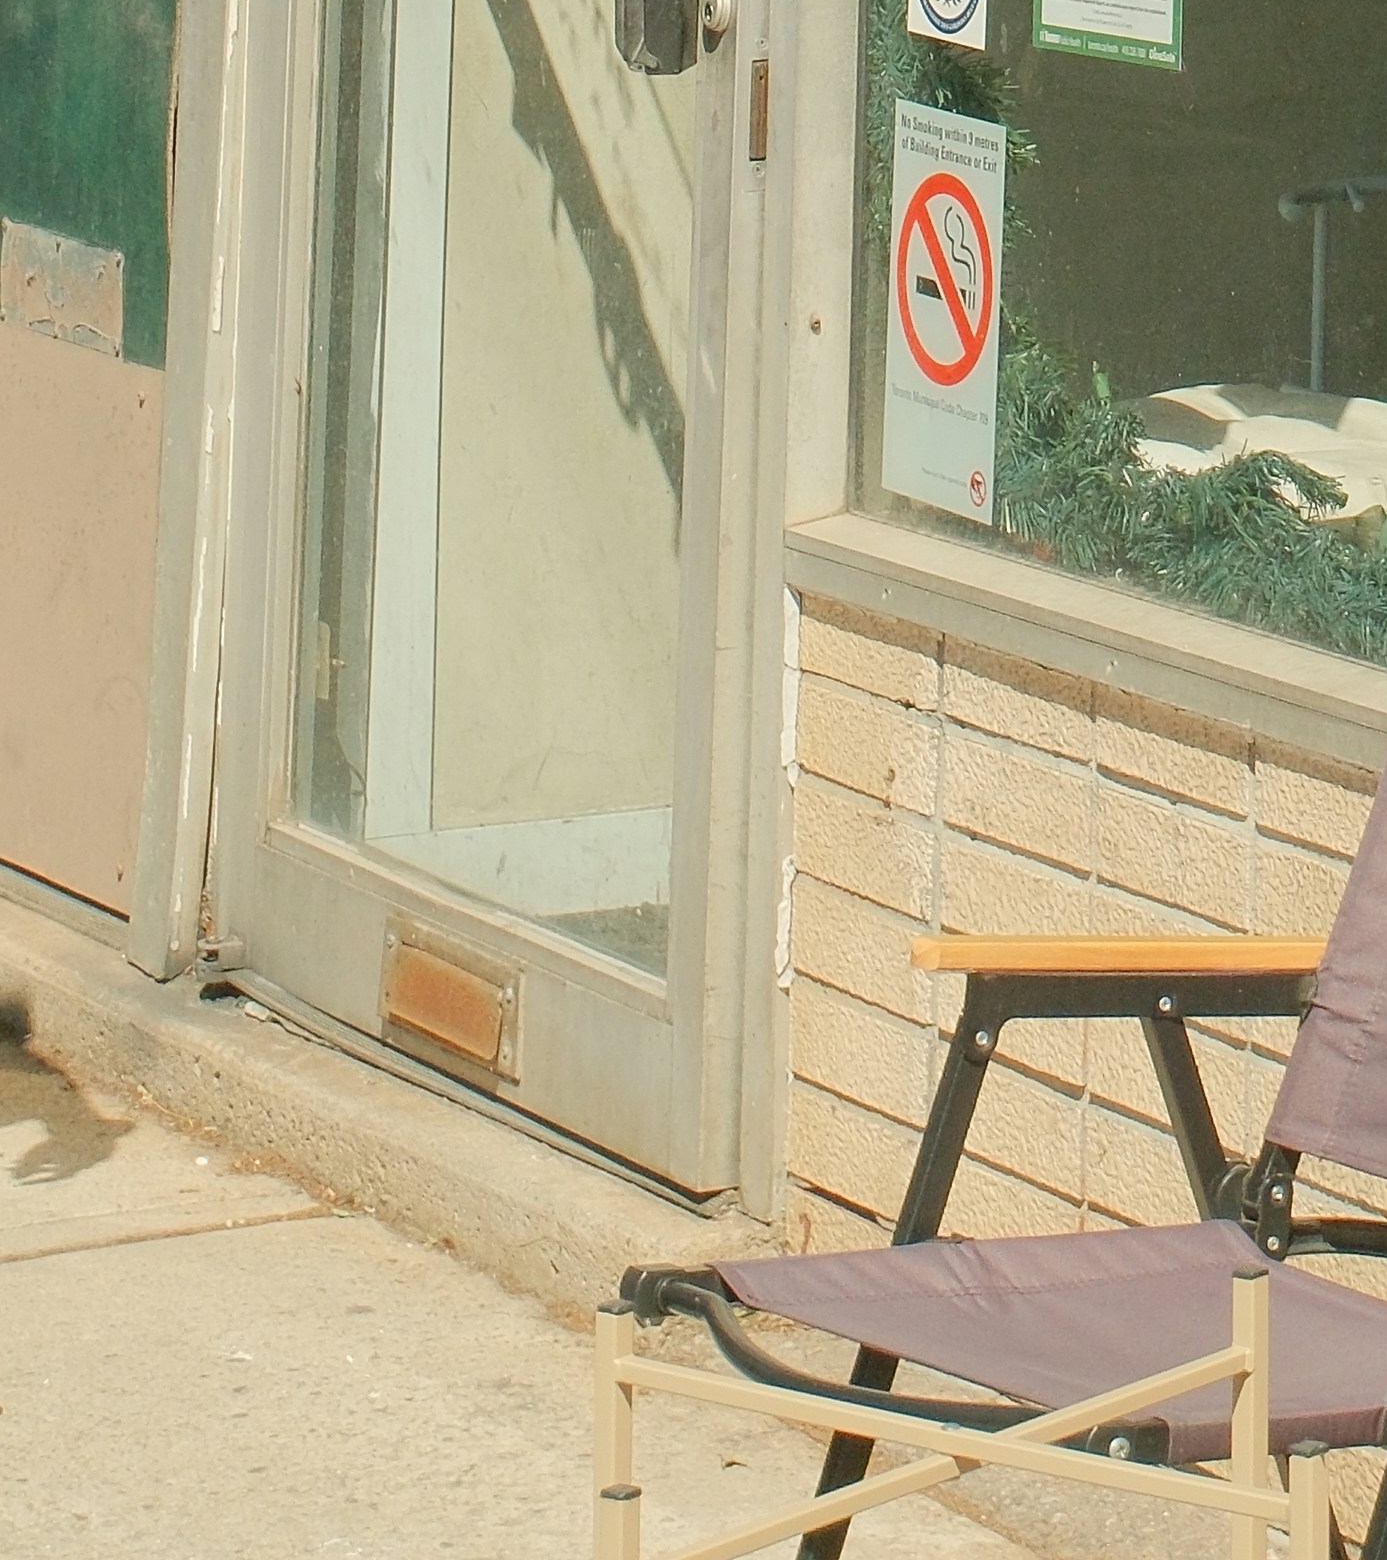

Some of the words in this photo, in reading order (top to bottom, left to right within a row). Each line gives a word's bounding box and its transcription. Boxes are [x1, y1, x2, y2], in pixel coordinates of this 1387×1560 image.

[901, 113, 911, 129] No
[913, 117, 943, 140] Smoking
[944, 127, 967, 144] within
[974, 135, 999, 152] metres
[901, 135, 910, 149] of
[910, 137, 940, 161] Building
[941, 145, 972, 167] Entrance
[974, 157, 982, 169] or
[983, 156, 998, 173] Exit
